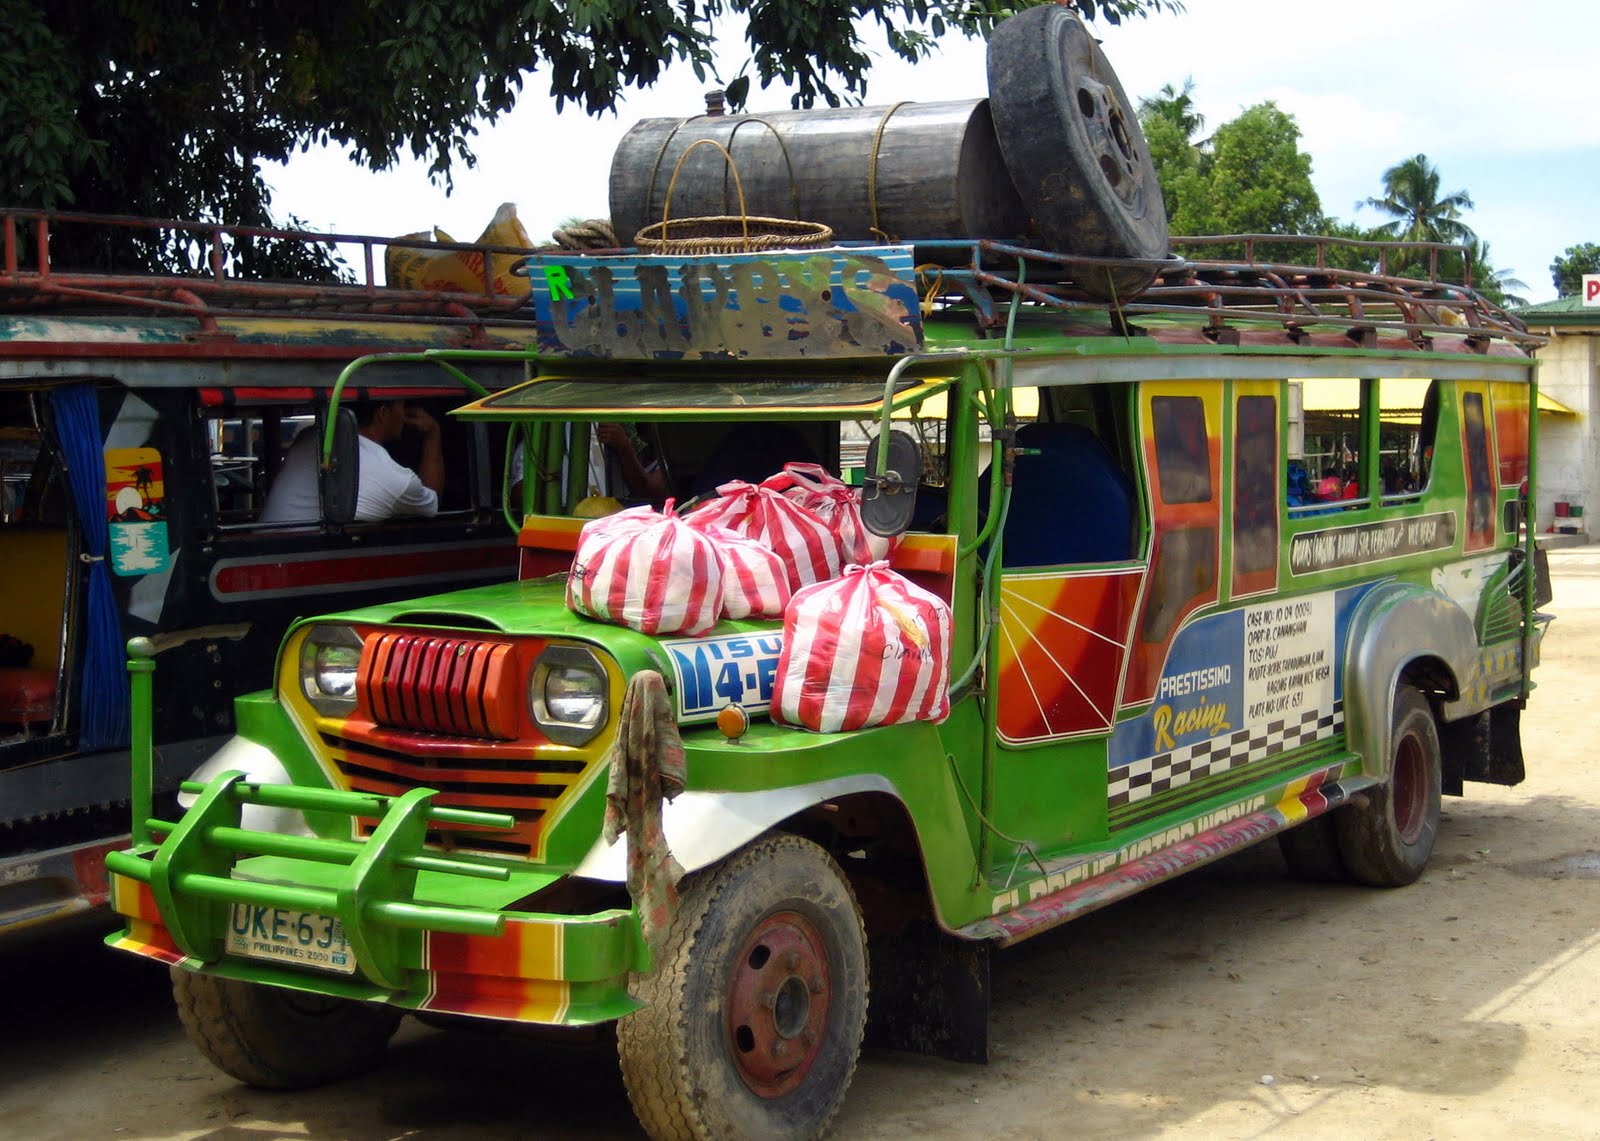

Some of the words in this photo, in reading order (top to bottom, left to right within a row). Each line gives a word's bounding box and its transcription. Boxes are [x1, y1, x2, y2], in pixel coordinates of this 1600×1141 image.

[543, 265, 574, 301] R
[1247, 611, 1262, 627] CASE
[1160, 664, 1231, 700] PRESTISSIMO
[1153, 695, 1231, 752] Racing
[253, 942, 304, 958] PHILIPPINES
